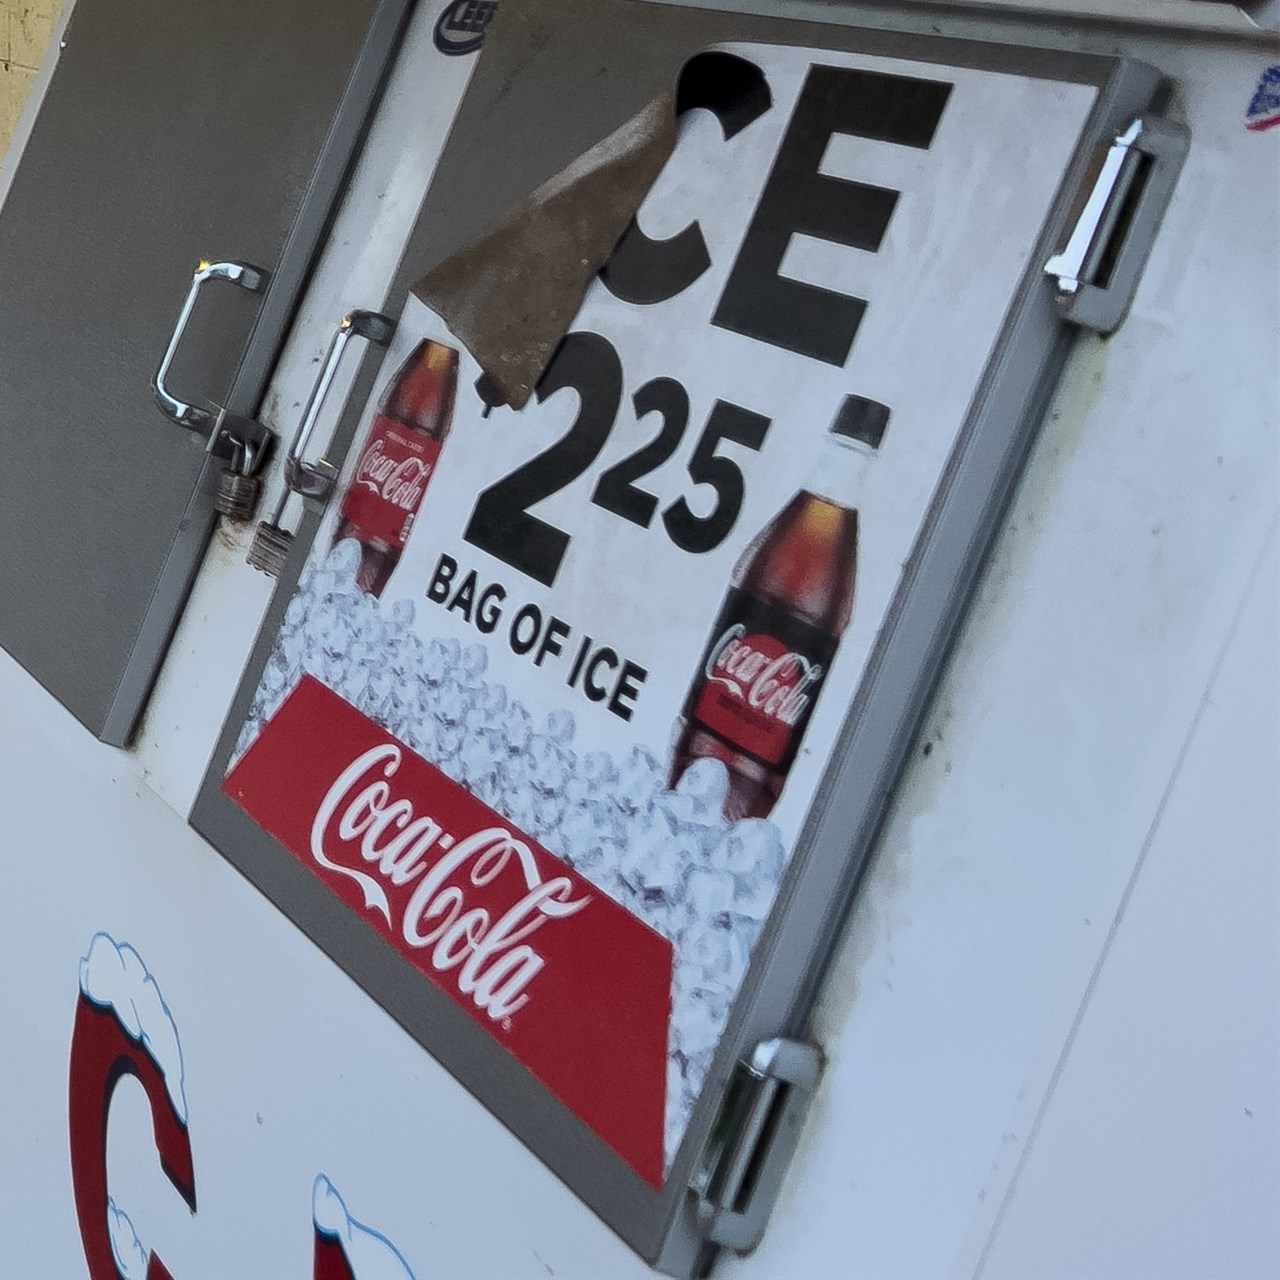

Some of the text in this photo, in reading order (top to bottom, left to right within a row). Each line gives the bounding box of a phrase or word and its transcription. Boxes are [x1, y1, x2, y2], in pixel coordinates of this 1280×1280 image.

[357, 438, 431, 511] Coca-Cola
[426, 552, 507, 634] BAG
[509, 603, 571, 667] OF
[567, 634, 648, 722] ICE
[705, 622, 823, 725] Coca-Cola
[310, 743, 593, 1019] Coca-Cola
